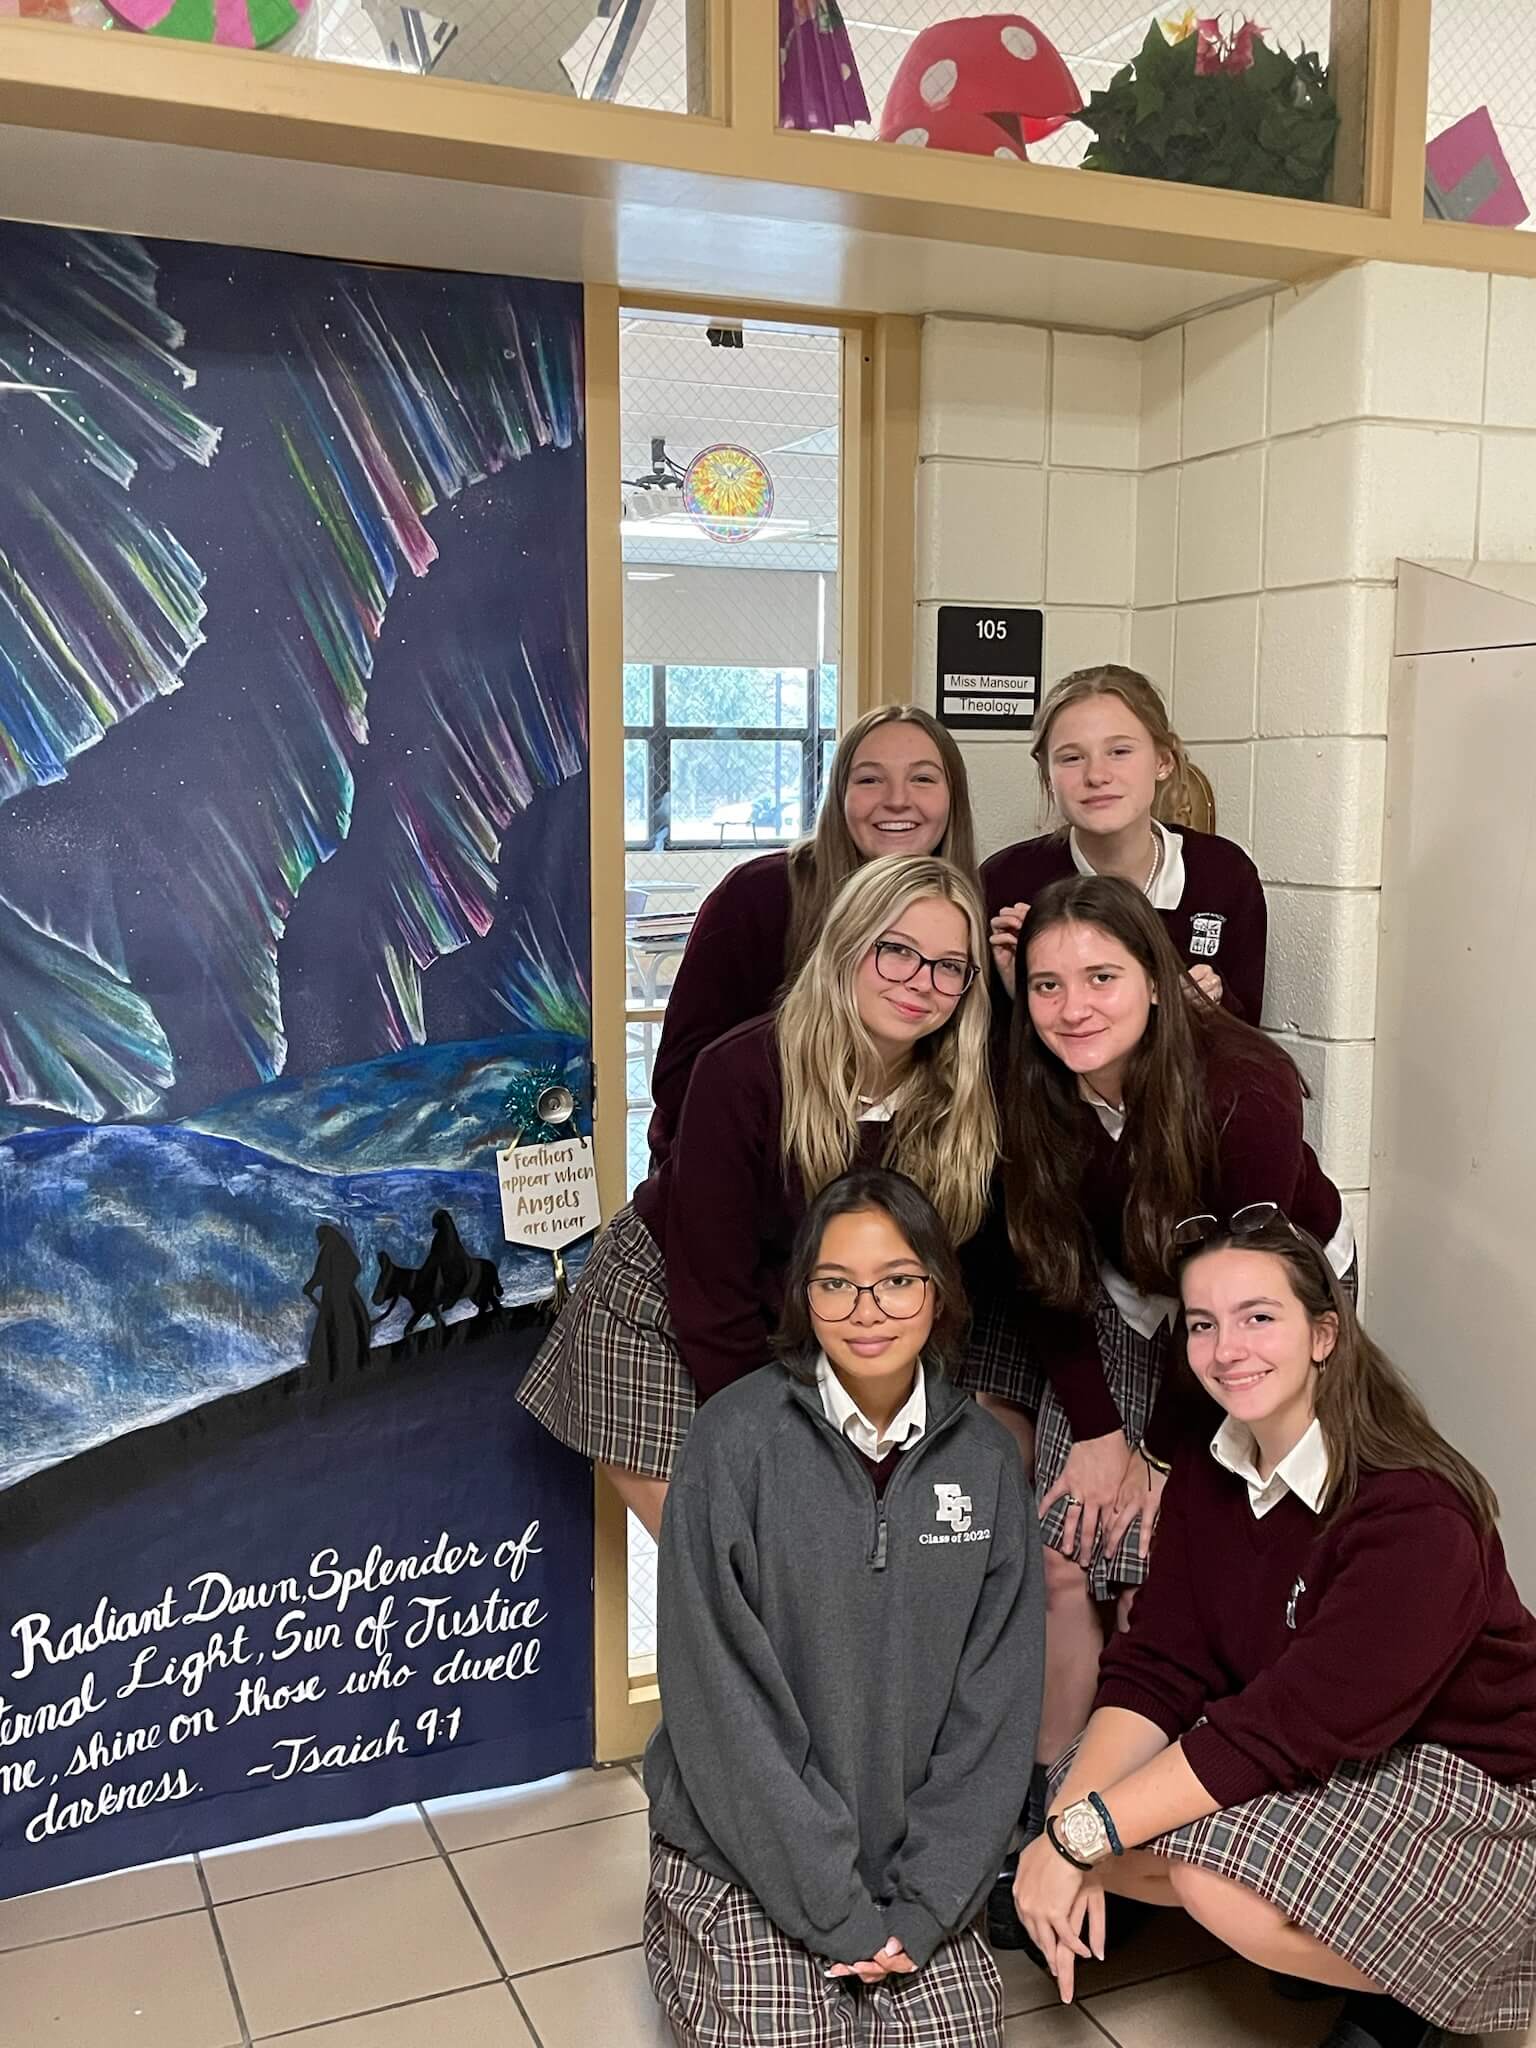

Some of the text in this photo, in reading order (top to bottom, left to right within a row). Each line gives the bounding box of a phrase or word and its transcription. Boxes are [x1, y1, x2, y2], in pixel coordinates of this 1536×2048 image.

[976, 619, 1007, 640] 105
[950, 675, 1028, 689] Miss Mansour
[960, 697, 1019, 716] Theology
[514, 1147, 574, 1170] Feathers
[502, 1166, 594, 1194] appear when
[517, 1189, 580, 1217] Angels
[523, 1215, 586, 1235] are near
[919, 1529, 992, 1544] Class of 2022
[10, 1586, 182, 1679] Radiant
[493, 1519, 543, 1583] of
[115, 1625, 265, 1700] Light,
[271, 1610, 343, 1661] Sun
[354, 1595, 400, 1657] of
[404, 1596, 549, 1649] Justice
[64, 1725, 163, 1778] shine
[168, 1706, 220, 1744] on
[226, 1679, 328, 1727] those
[337, 1652, 417, 1694] who
[432, 1638, 542, 1687] dwell
[415, 1706, 463, 1747] 9:1
